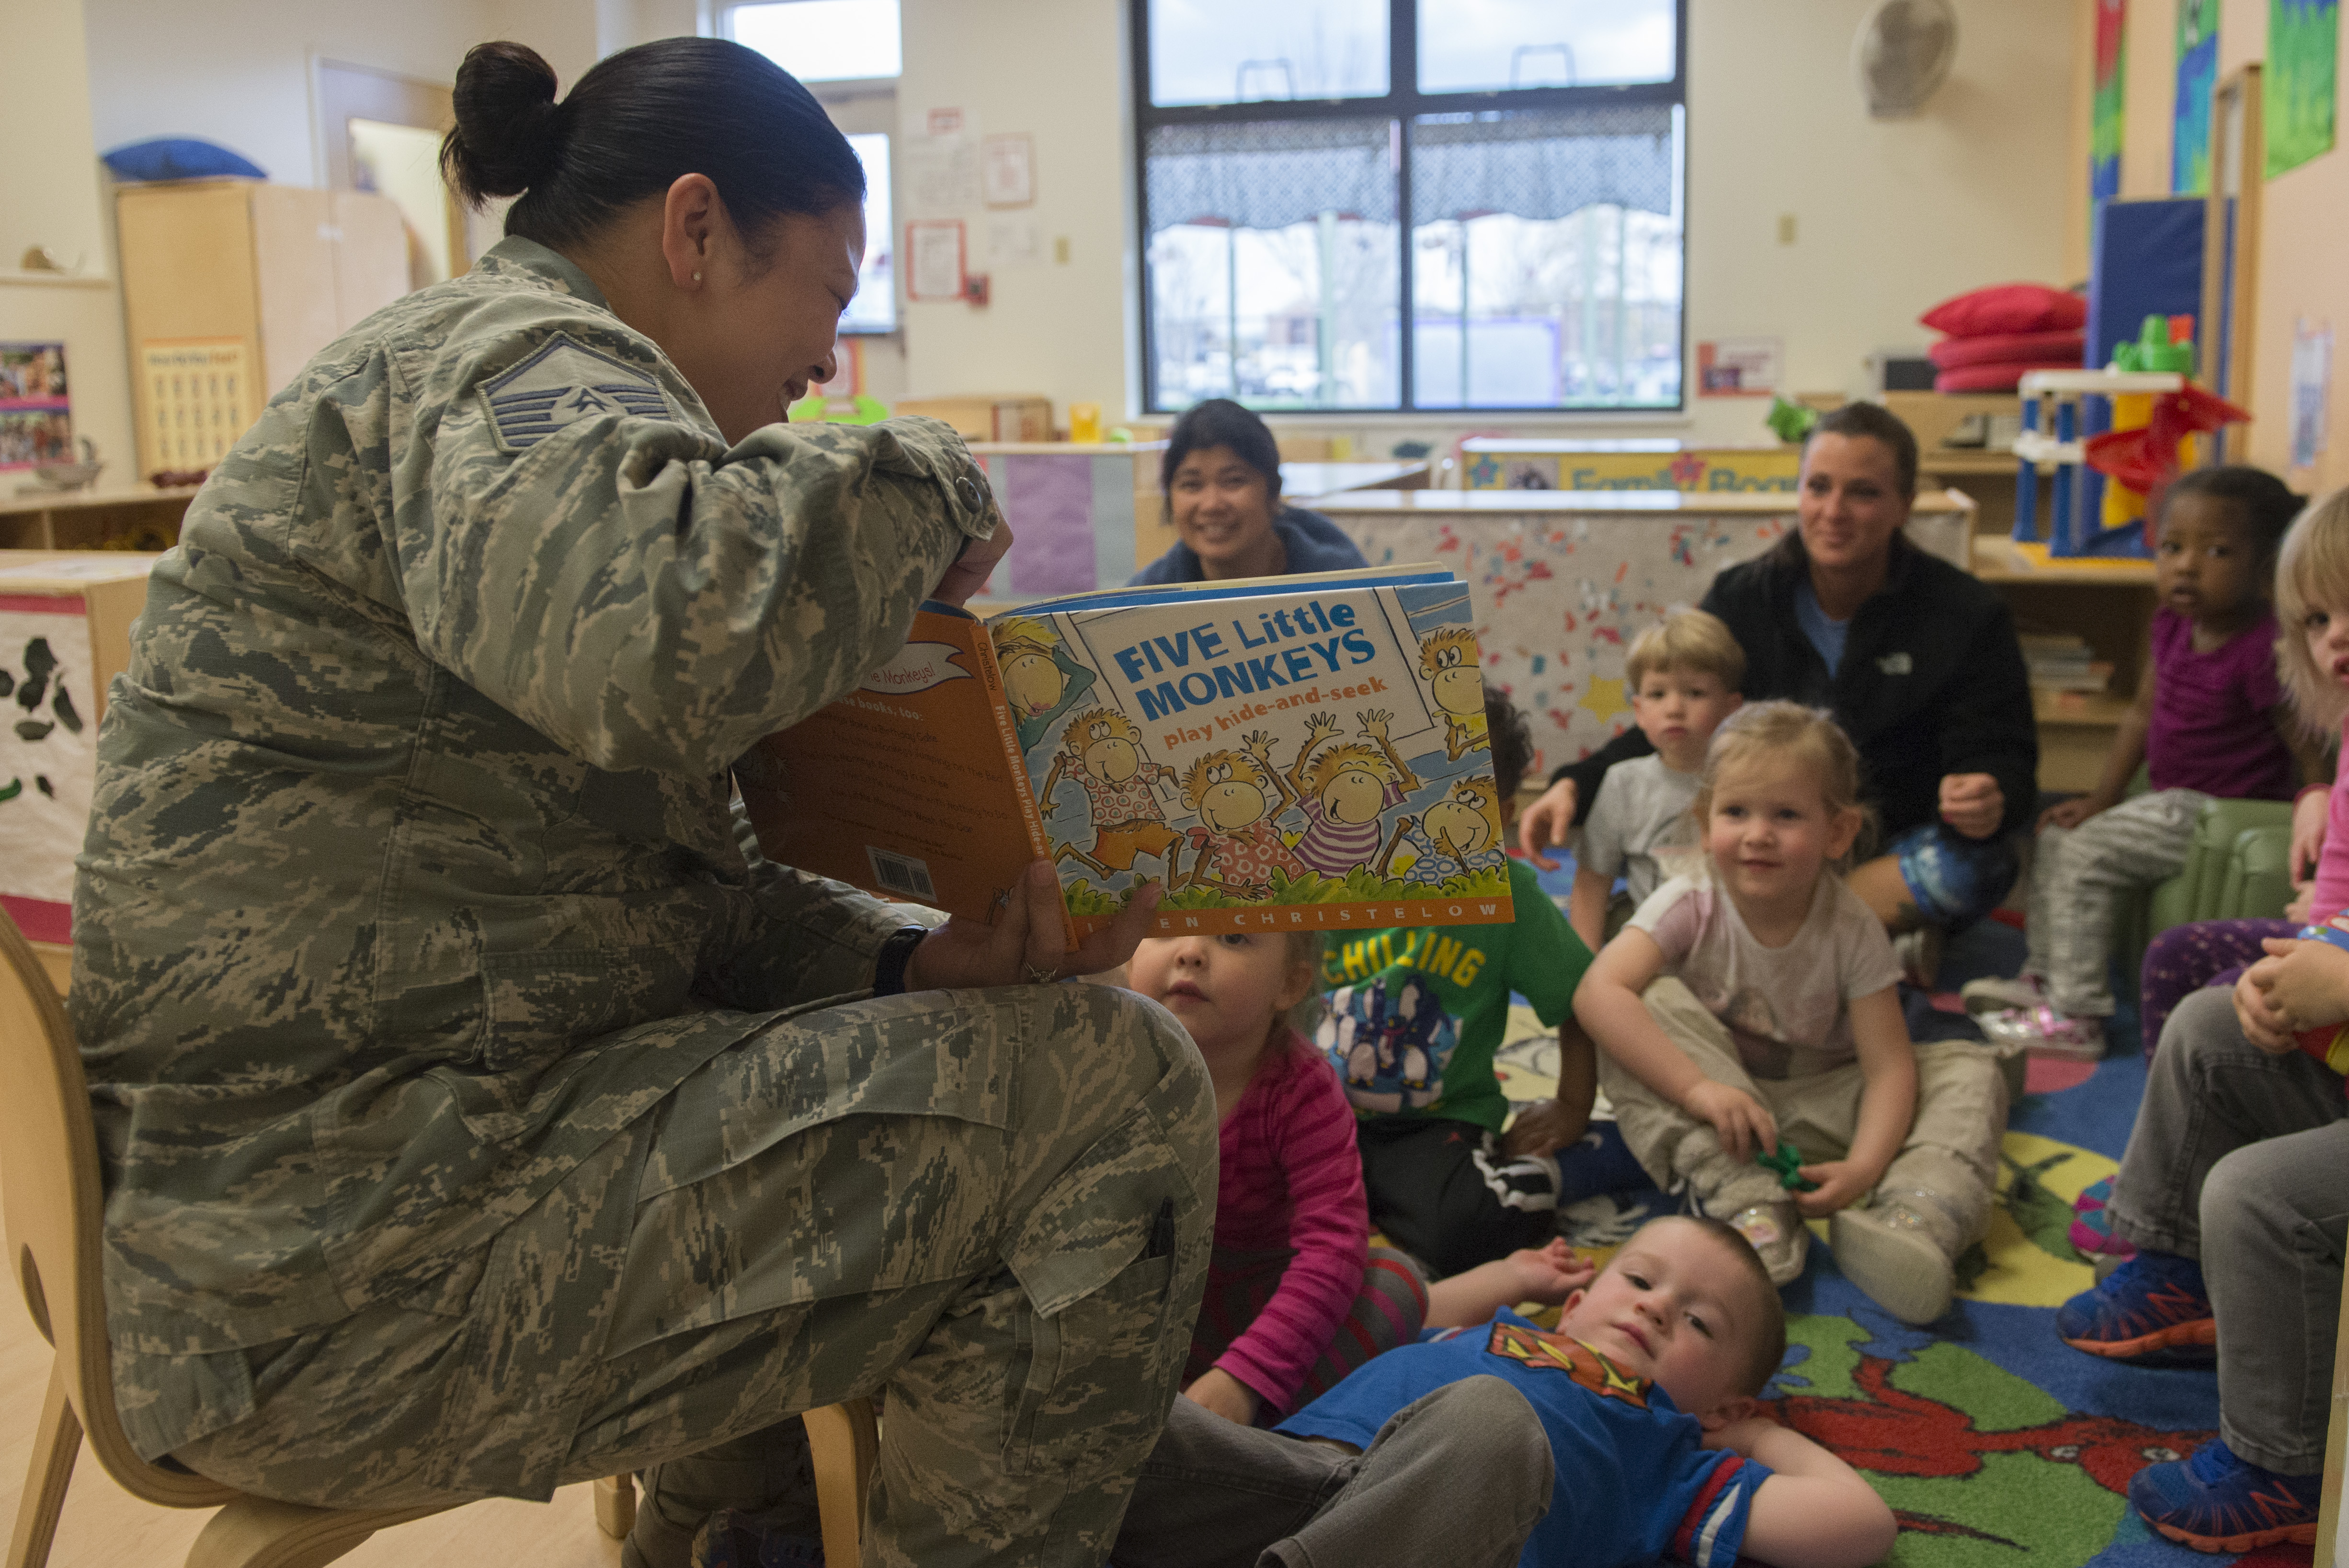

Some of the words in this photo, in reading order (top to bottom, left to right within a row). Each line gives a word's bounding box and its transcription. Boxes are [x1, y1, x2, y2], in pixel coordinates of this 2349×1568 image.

[1113, 622, 1229, 684] FIVE
[1232, 601, 1355, 649] Little
[882, 661, 935, 684] Monkeys!
[978, 642, 997, 691] Christelow
[1135, 628, 1375, 721] MONKEYS
[857, 697, 897, 717] books,
[899, 706, 924, 721] too:
[1163, 724, 1214, 750] play
[1215, 676, 1388, 730] hide-and-seek
[914, 749, 951, 771] Jumping
[953, 762, 965, 772] on
[967, 765, 984, 778] the
[985, 770, 1003, 783] Bed
[995, 705, 1007, 726] Five
[1002, 727, 1016, 753] Little
[1009, 755, 1028, 798] Monkeys
[1022, 798, 1035, 819] Play
[929, 775, 949, 789] Tree
[913, 810, 936, 824] Wash
[939, 818, 955, 830] the
[957, 822, 973, 833] Car
[946, 800, 982, 819] Nothing
[1234, 904, 1496, 925] CHRISTELOW
